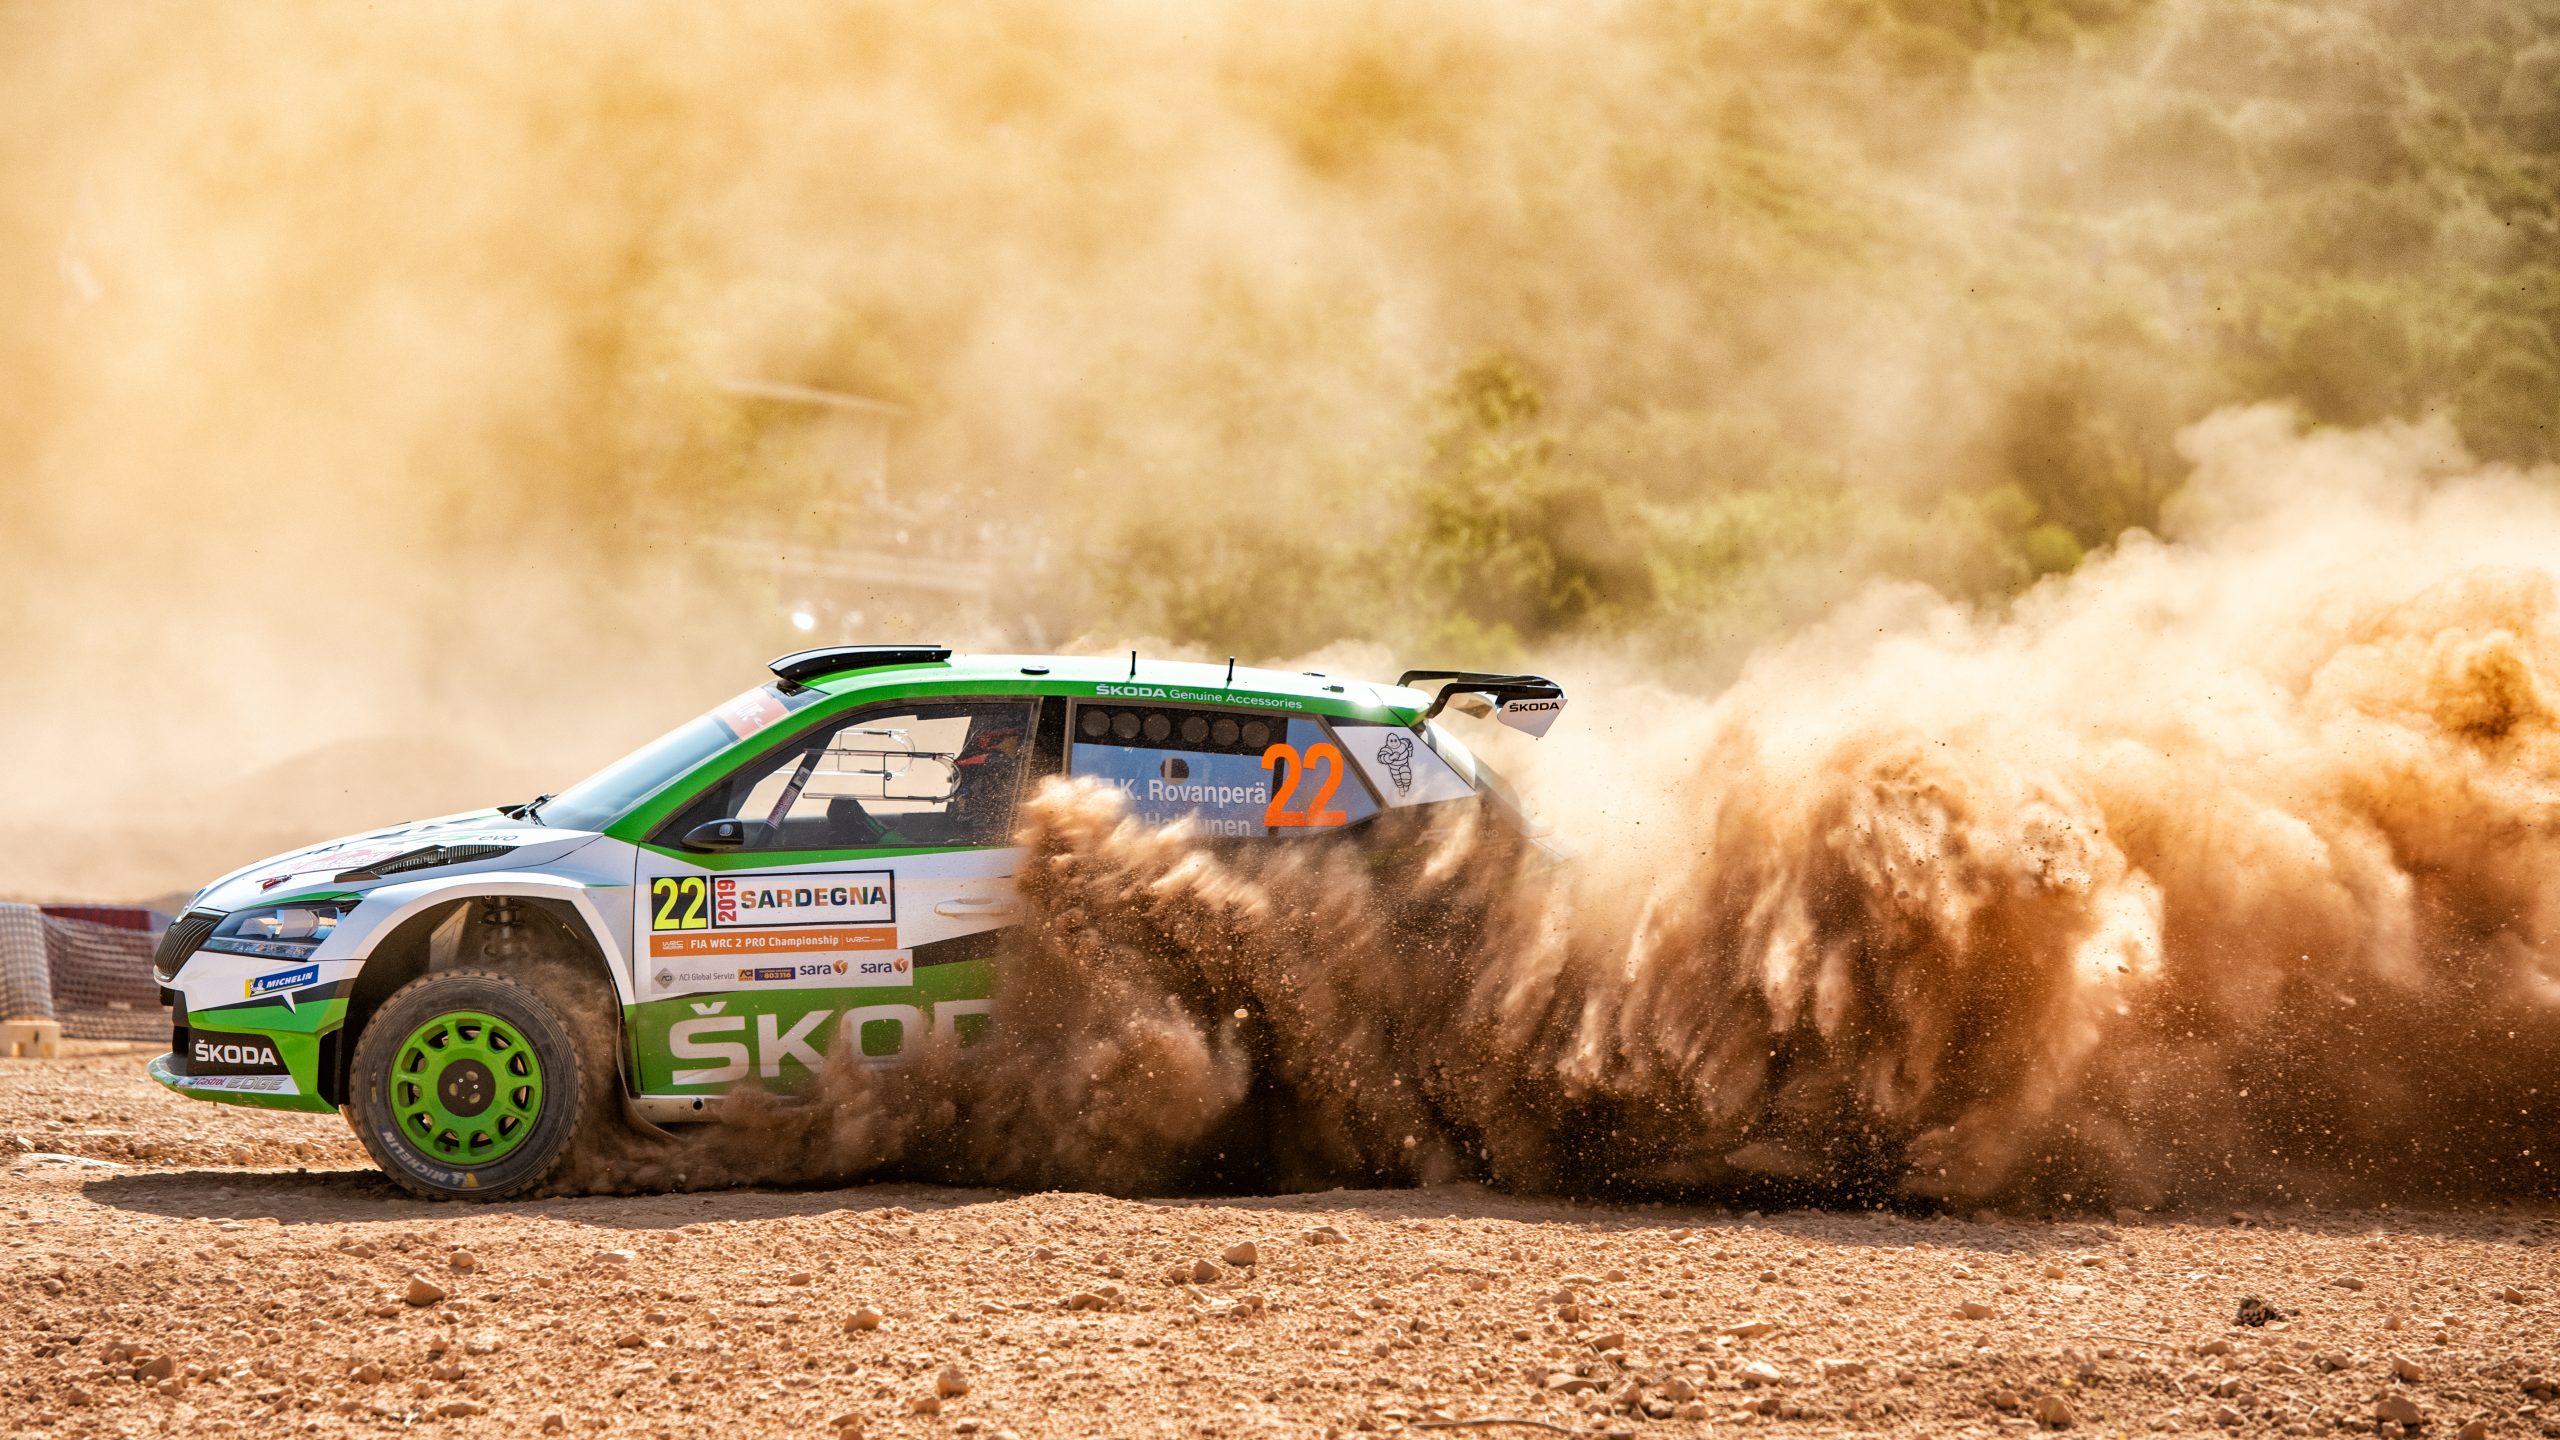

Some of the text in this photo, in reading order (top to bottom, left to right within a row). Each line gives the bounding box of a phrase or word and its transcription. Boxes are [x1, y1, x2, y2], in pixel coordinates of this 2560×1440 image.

[1096, 684, 1303, 709] ŠKODA Genuine Accessories
[1509, 701, 1560, 713] ŠKODA
[1148, 779, 1267, 809] Rovanperä
[1261, 743, 1347, 828] 22
[653, 877, 707, 930] 22
[716, 879, 737, 922] 2019
[740, 886, 887, 909] SARDEGNA
[690, 940, 707, 949] FIA
[710, 939, 732, 949] WRC
[735, 938, 742, 948] 2
[745, 938, 766, 947] PRO
[768, 935, 839, 948] Championship
[691, 973, 711, 981] Global
[713, 972, 735, 980] Servizi
[800, 964, 832, 976] sara
[860, 962, 893, 974] sara
[266, 971, 314, 989] MICHELIN
[195, 1039, 278, 1066] ŠKODA
[225, 1076, 288, 1091] EDGE
[381, 1131, 449, 1182] MICHELIN
